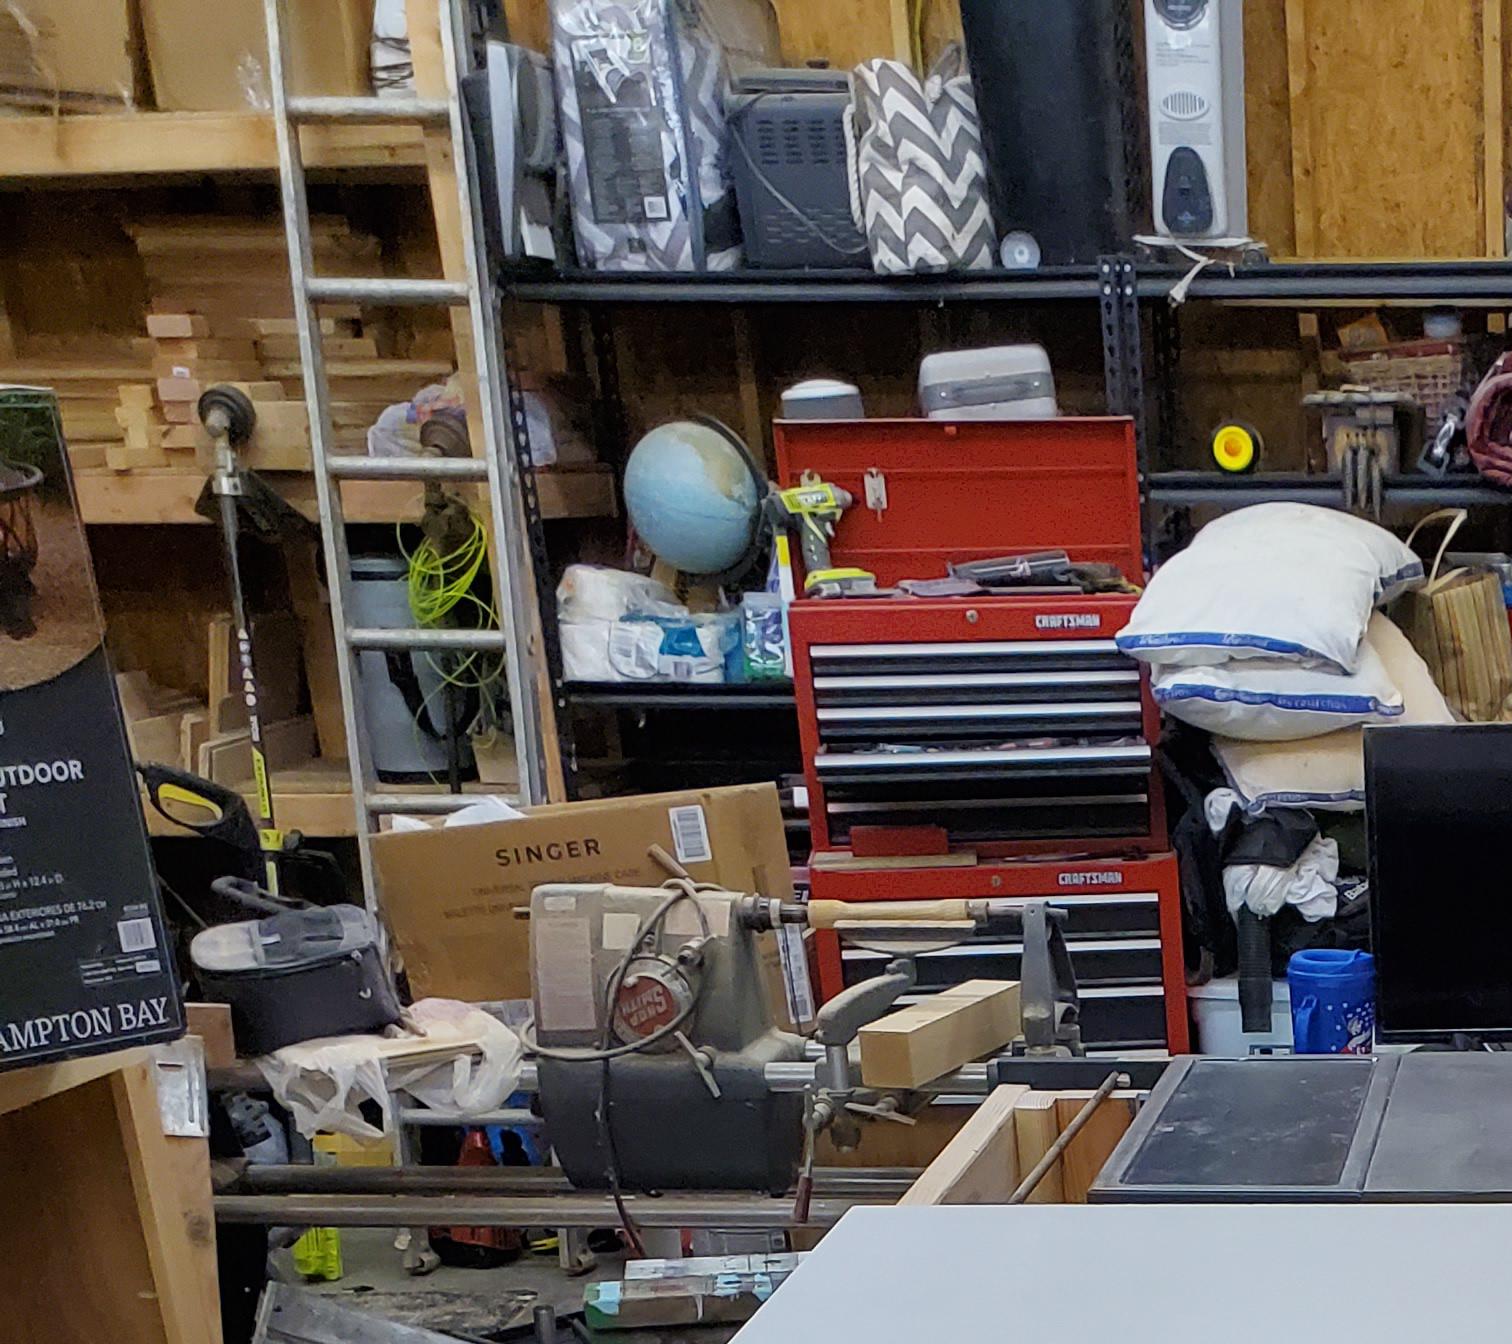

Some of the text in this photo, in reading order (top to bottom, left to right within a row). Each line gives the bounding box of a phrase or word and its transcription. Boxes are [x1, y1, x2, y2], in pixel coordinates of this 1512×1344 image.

[1035, 613, 1100, 629] CRAFTSMAN
[494, 838, 601, 867] SINGER
[1058, 871, 1122, 886] CRAFTSMAN
[117, 997, 168, 1031] BAY
